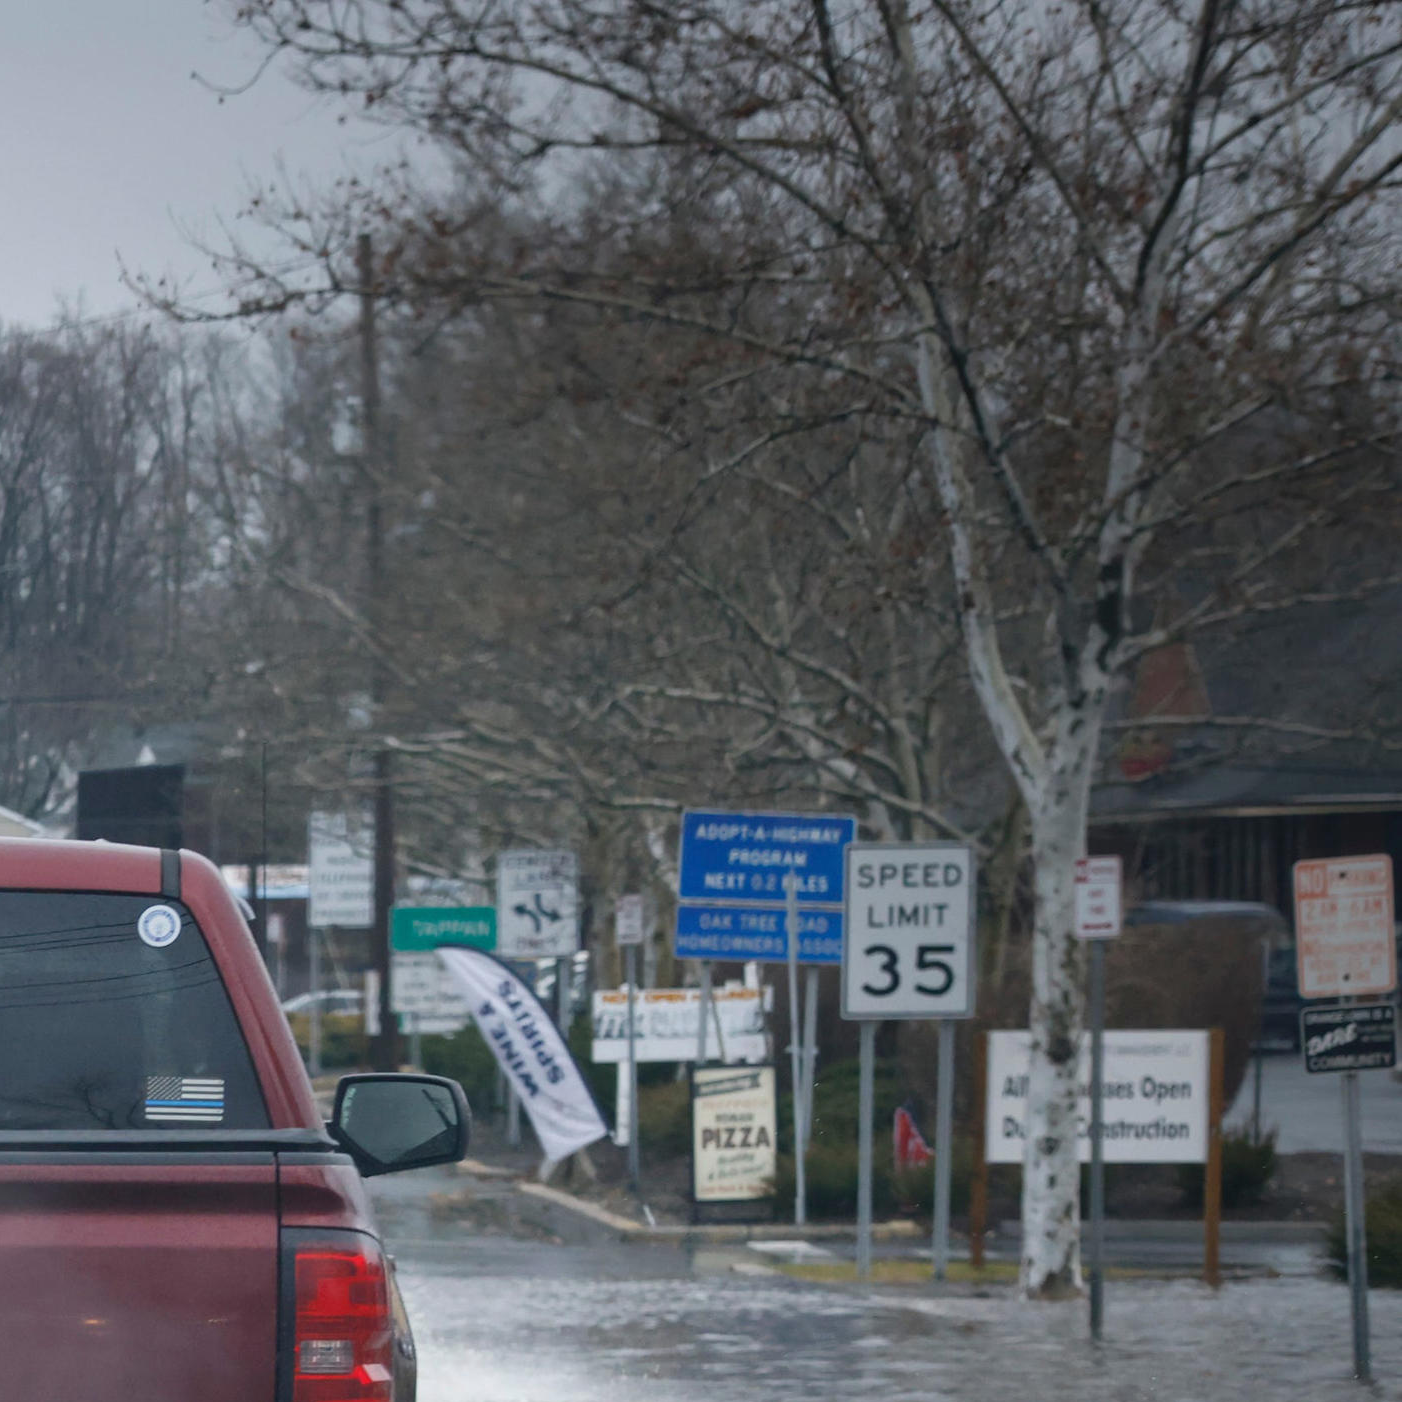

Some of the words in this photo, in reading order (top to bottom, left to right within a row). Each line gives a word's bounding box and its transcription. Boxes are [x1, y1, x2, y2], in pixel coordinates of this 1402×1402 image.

[696, 824, 841, 843] ADOPT-A-HIGHWAY
[728, 849, 807, 867] PROGRAM
[704, 873, 745, 890] NEXT
[857, 862, 963, 888] SPEED
[699, 914, 732, 929] OAK
[740, 915, 777, 932] TREE
[867, 903, 950, 928] LIMIT
[861, 943, 955, 997] 35
[498, 980, 565, 1085] SPIRITS
[490, 1020, 539, 1097] WINE
[1309, 1053, 1392, 1071] COMMUNITY
[1140, 1075, 1193, 1104] Open
[701, 1126, 771, 1149] PIZZA
[1077, 1116, 1190, 1140] Cnstruction
